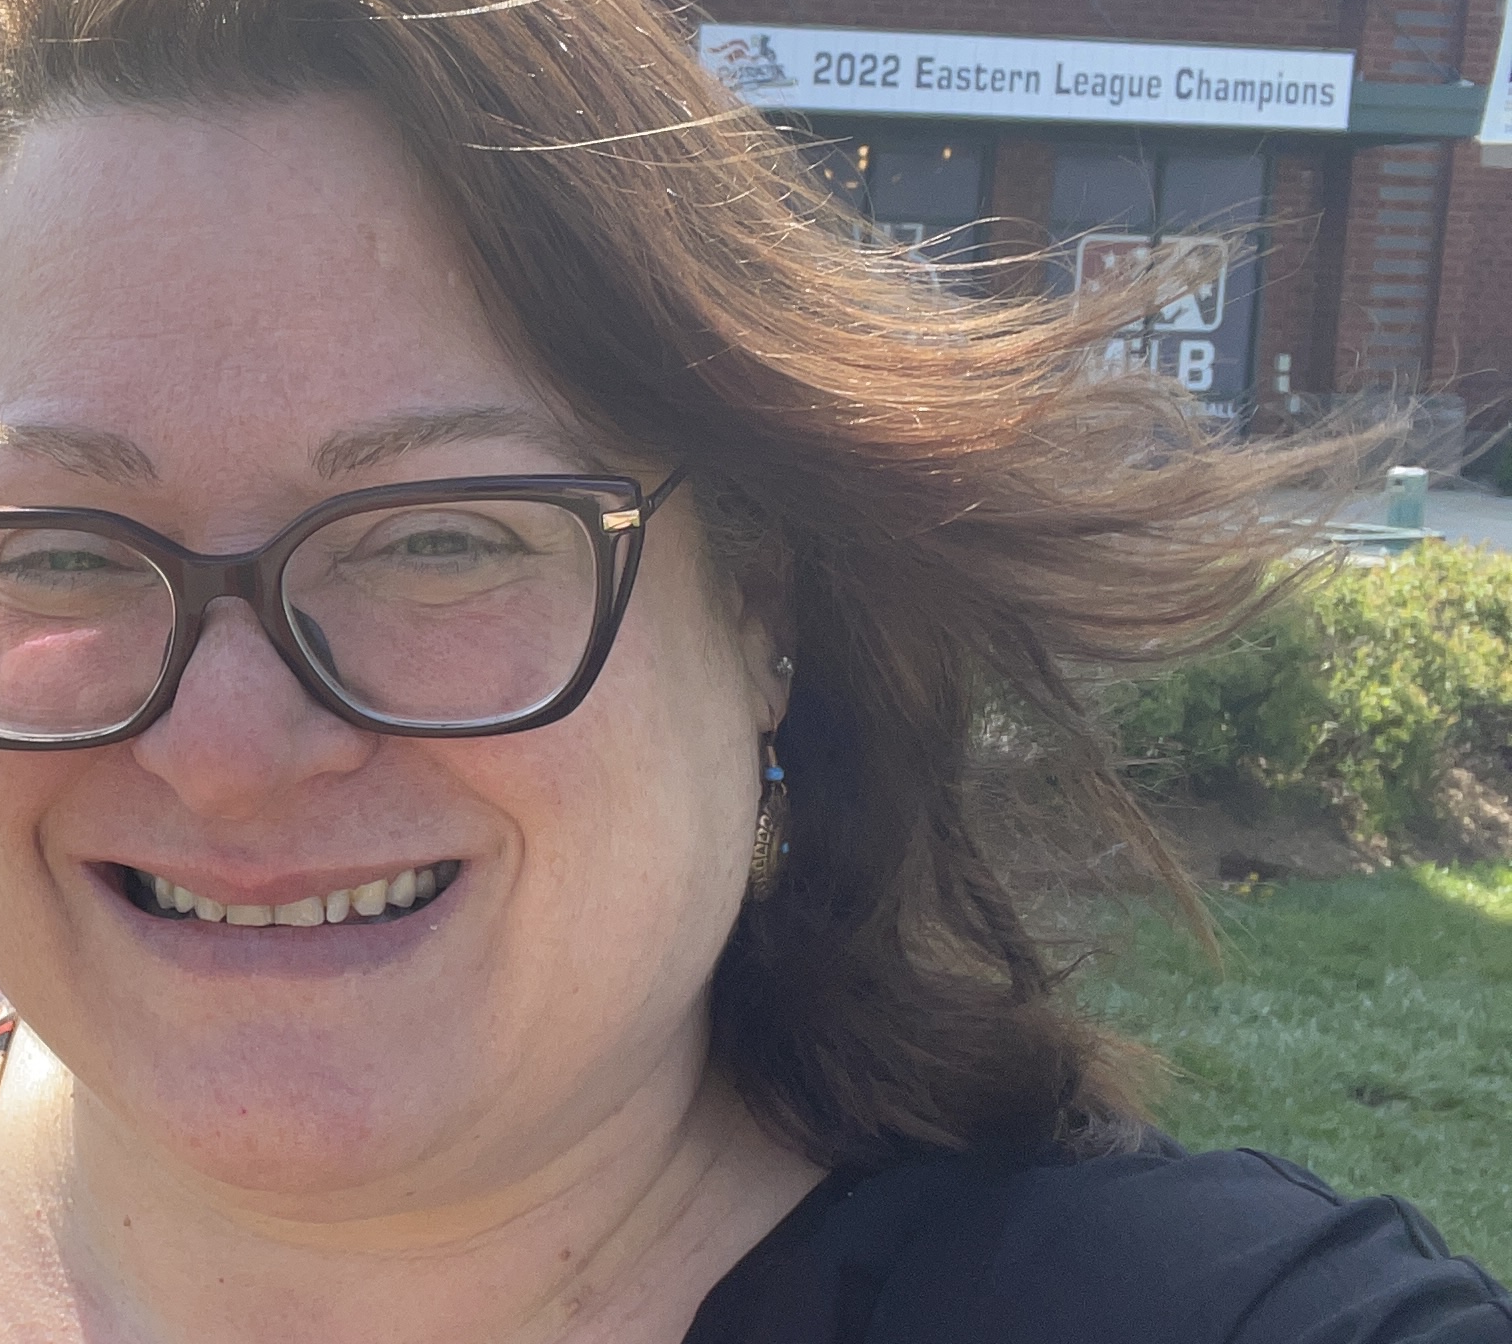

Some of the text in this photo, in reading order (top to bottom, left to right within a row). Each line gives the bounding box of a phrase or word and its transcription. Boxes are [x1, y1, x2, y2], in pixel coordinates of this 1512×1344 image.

[812, 51, 900, 89] 2022
[915, 56, 1041, 94] Eastern
[1054, 62, 1163, 106] League
[1175, 67, 1336, 112] Champions
